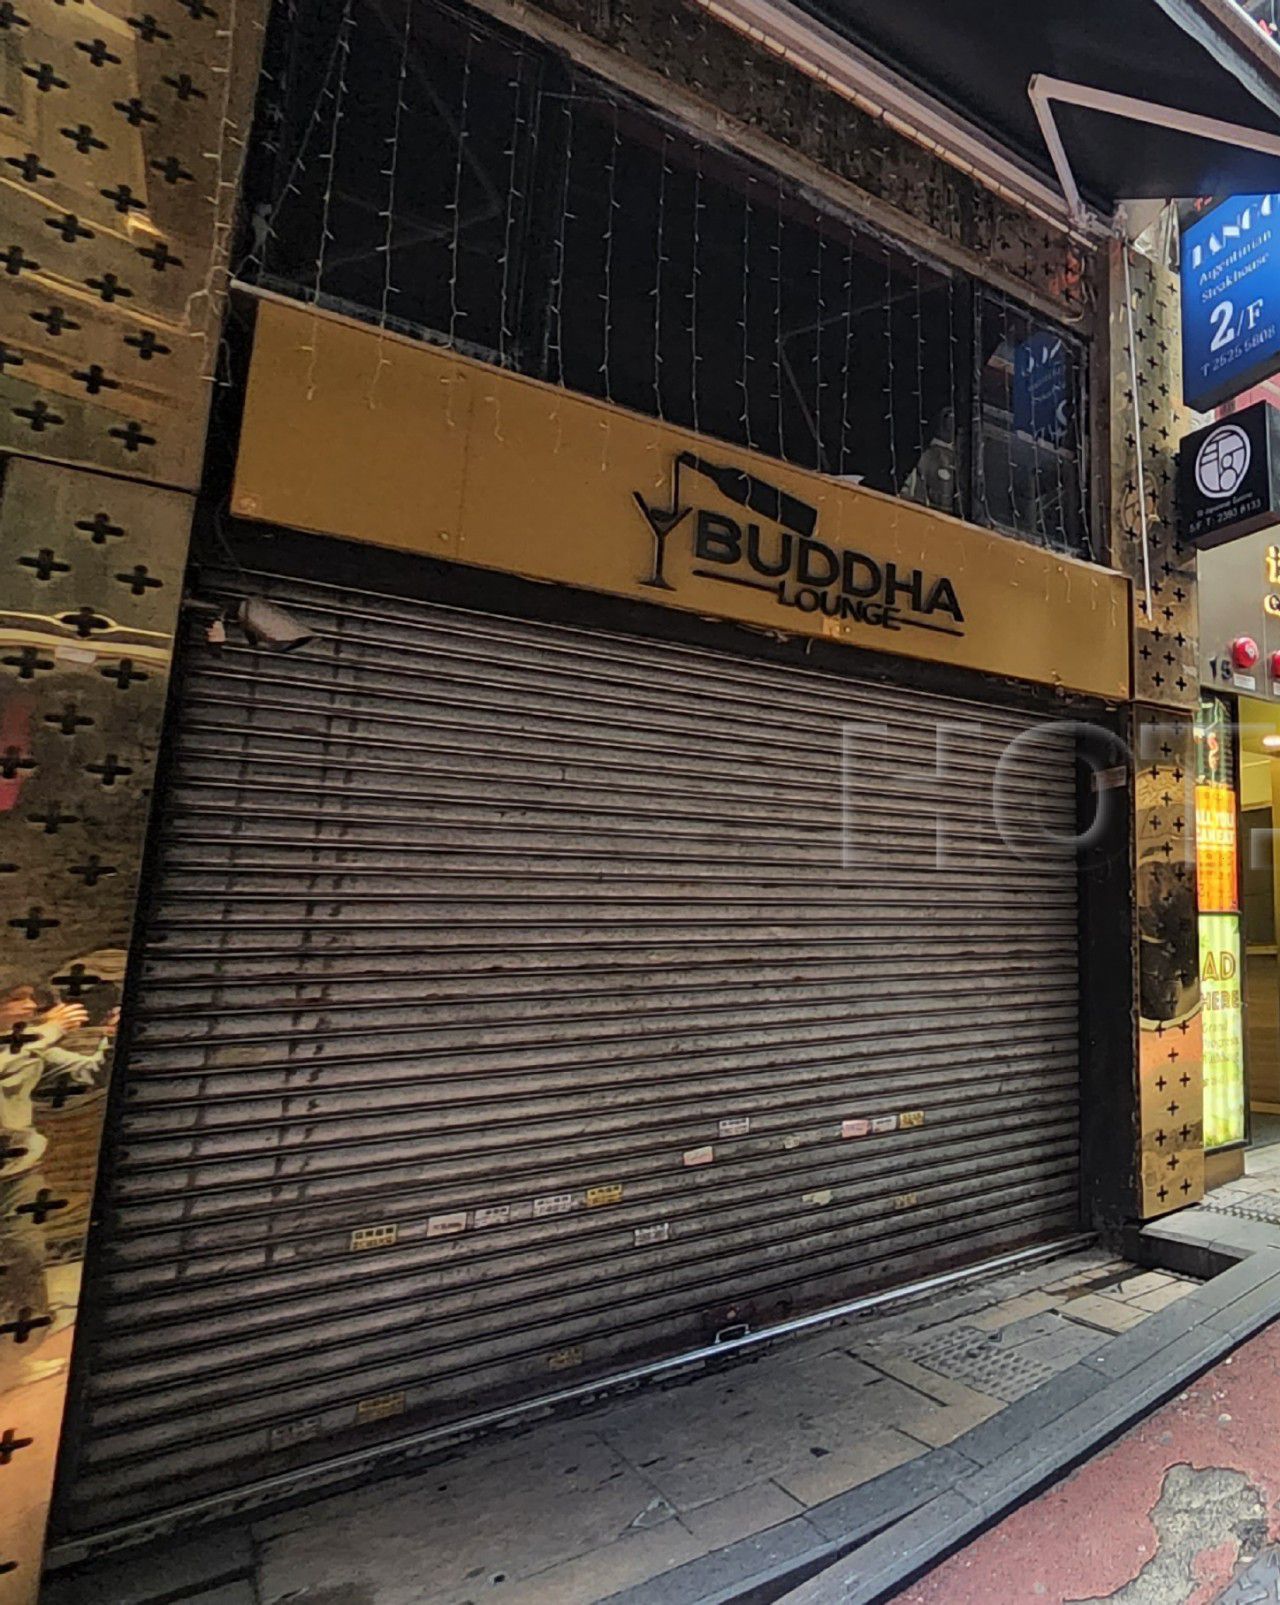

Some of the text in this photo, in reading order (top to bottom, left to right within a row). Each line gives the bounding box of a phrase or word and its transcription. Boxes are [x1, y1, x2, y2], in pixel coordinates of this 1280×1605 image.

[1201, 252, 1270, 303] Steakhouse
[1209, 298, 1264, 353] 2/F
[695, 508, 966, 624] BUDDHA
[776, 580, 902, 632] LOUNGE
[1201, 951, 1237, 982] AD
[1200, 989, 1240, 1012] HERE
